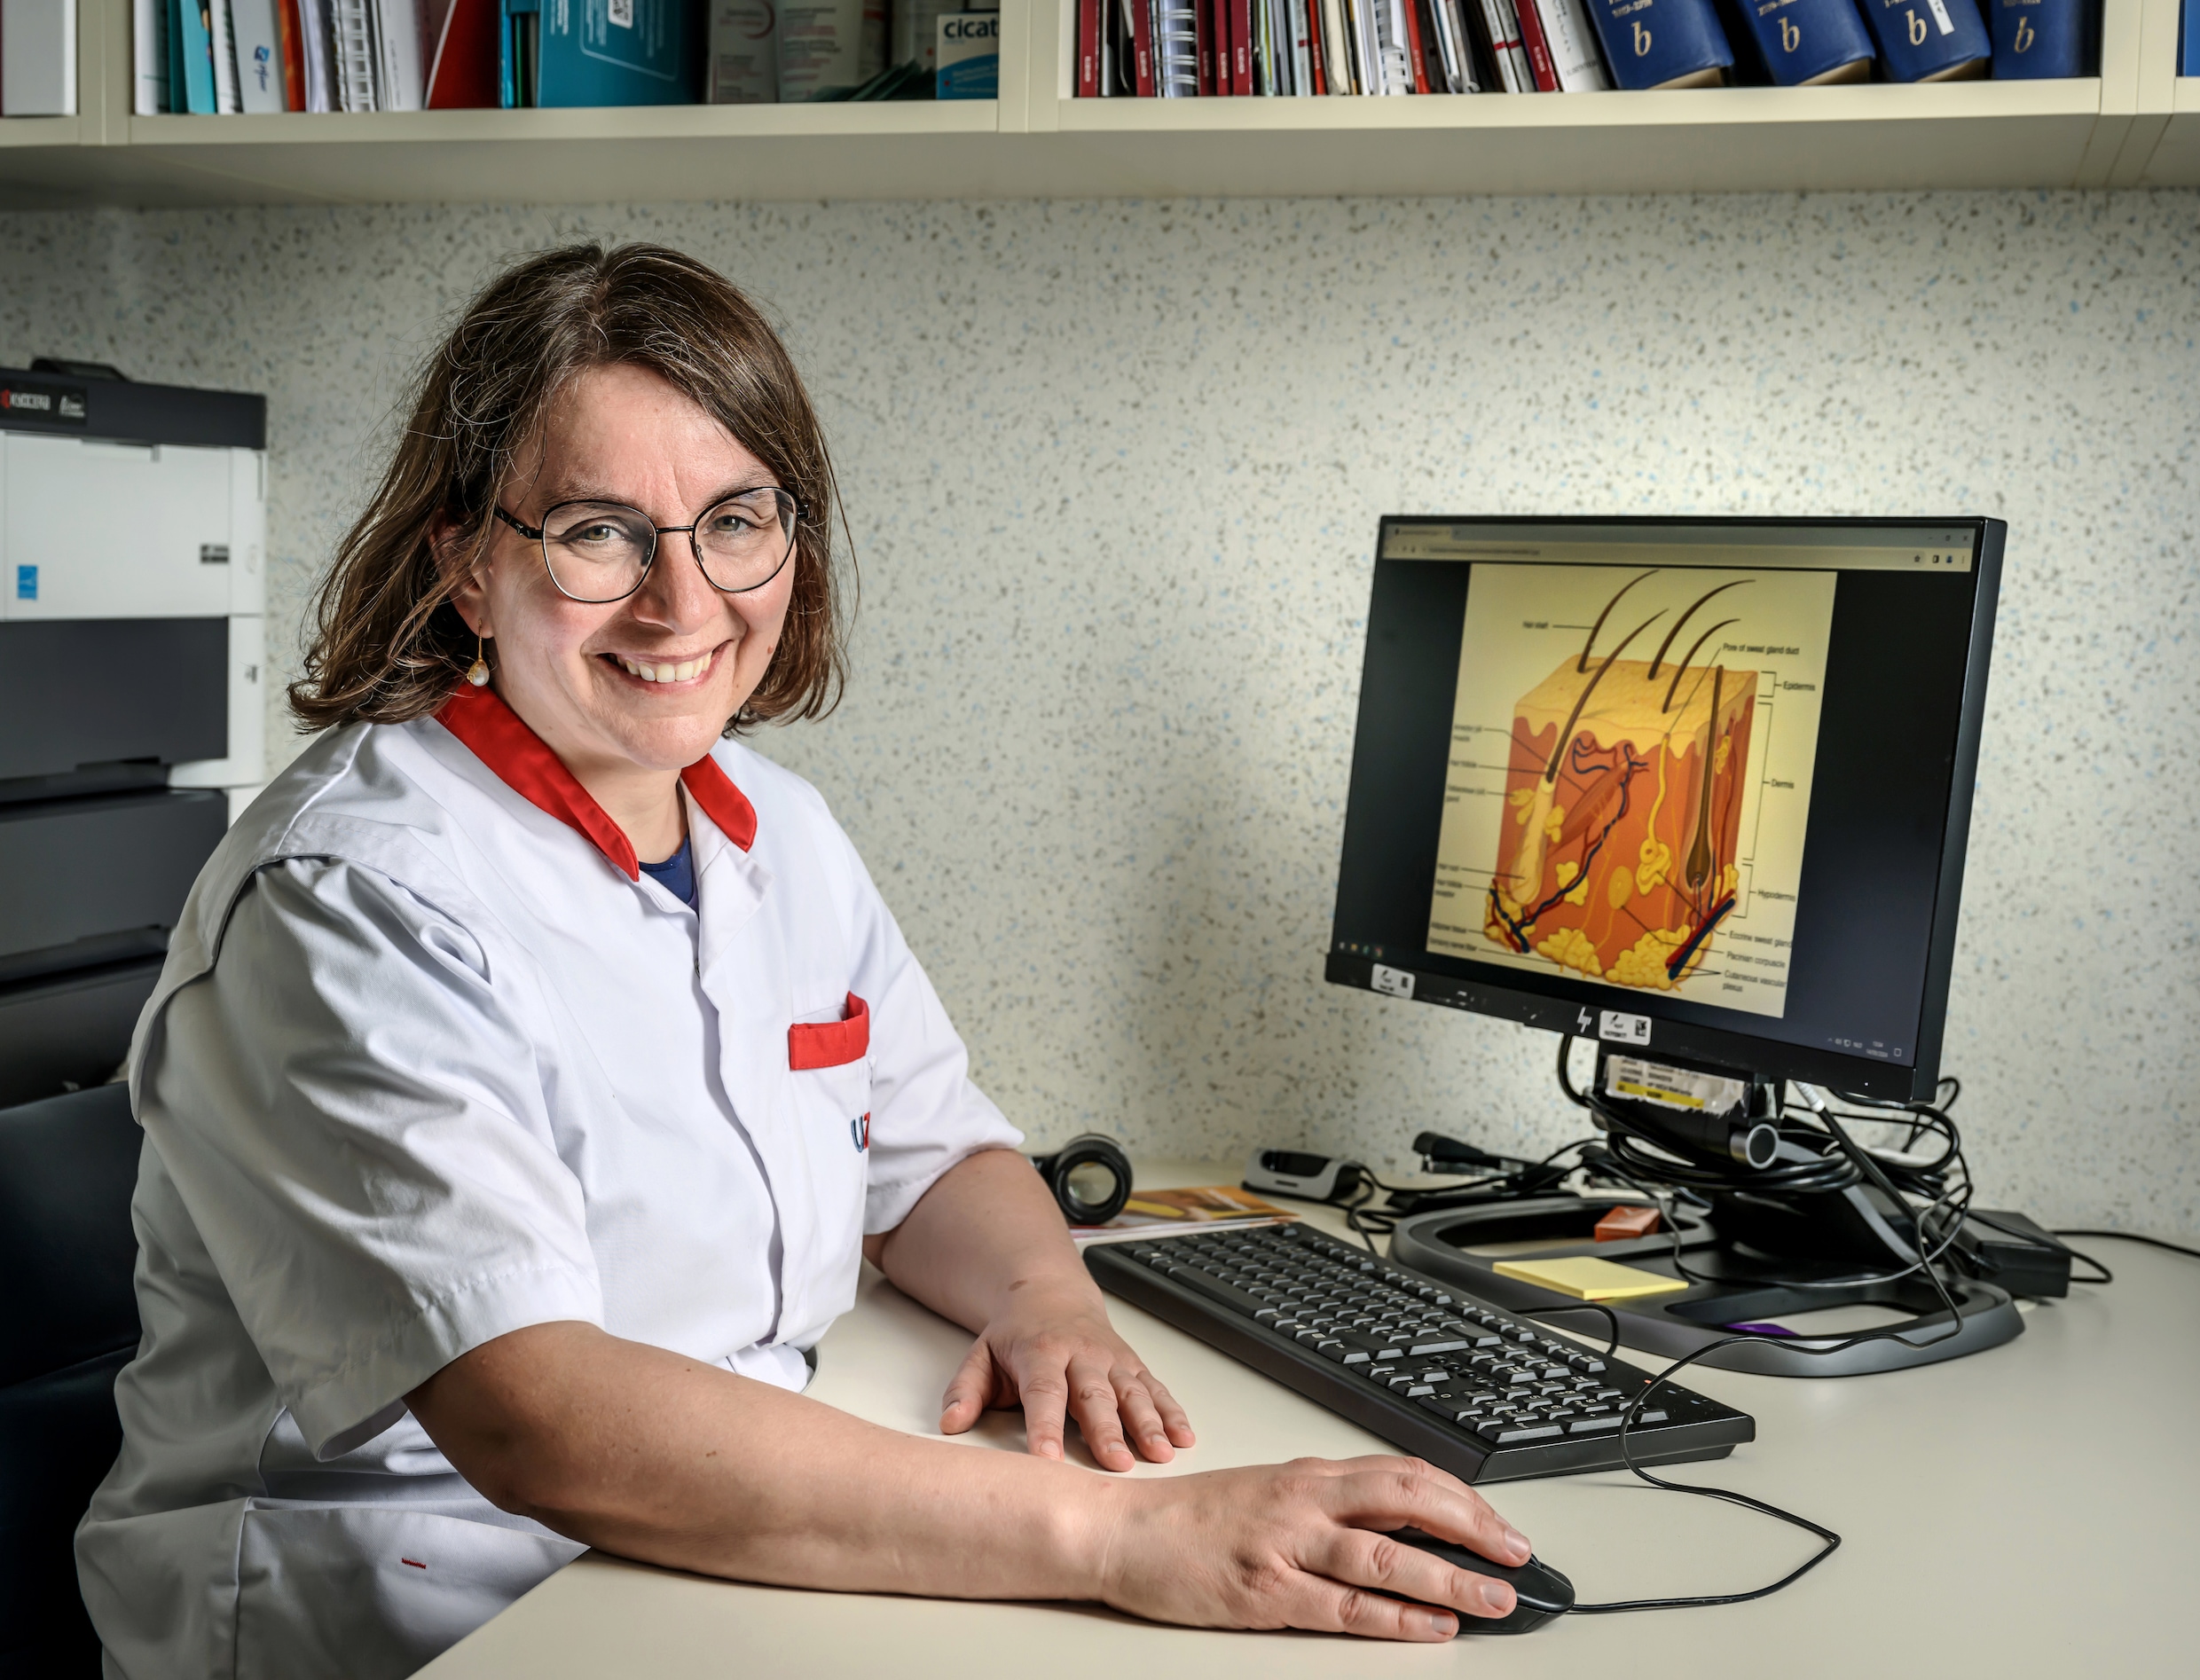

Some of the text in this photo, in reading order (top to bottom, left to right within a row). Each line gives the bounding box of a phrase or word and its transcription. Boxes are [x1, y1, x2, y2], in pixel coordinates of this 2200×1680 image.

[1630, 20, 1652, 57] b
[1778, 17, 1801, 53] b
[1905, 9, 1928, 46] b
[2014, 16, 2035, 54] b
[1782, 680, 1816, 691] Epidermis
[1771, 779, 1795, 789] Dermis
[1757, 890, 1796, 902] Hypodermis
